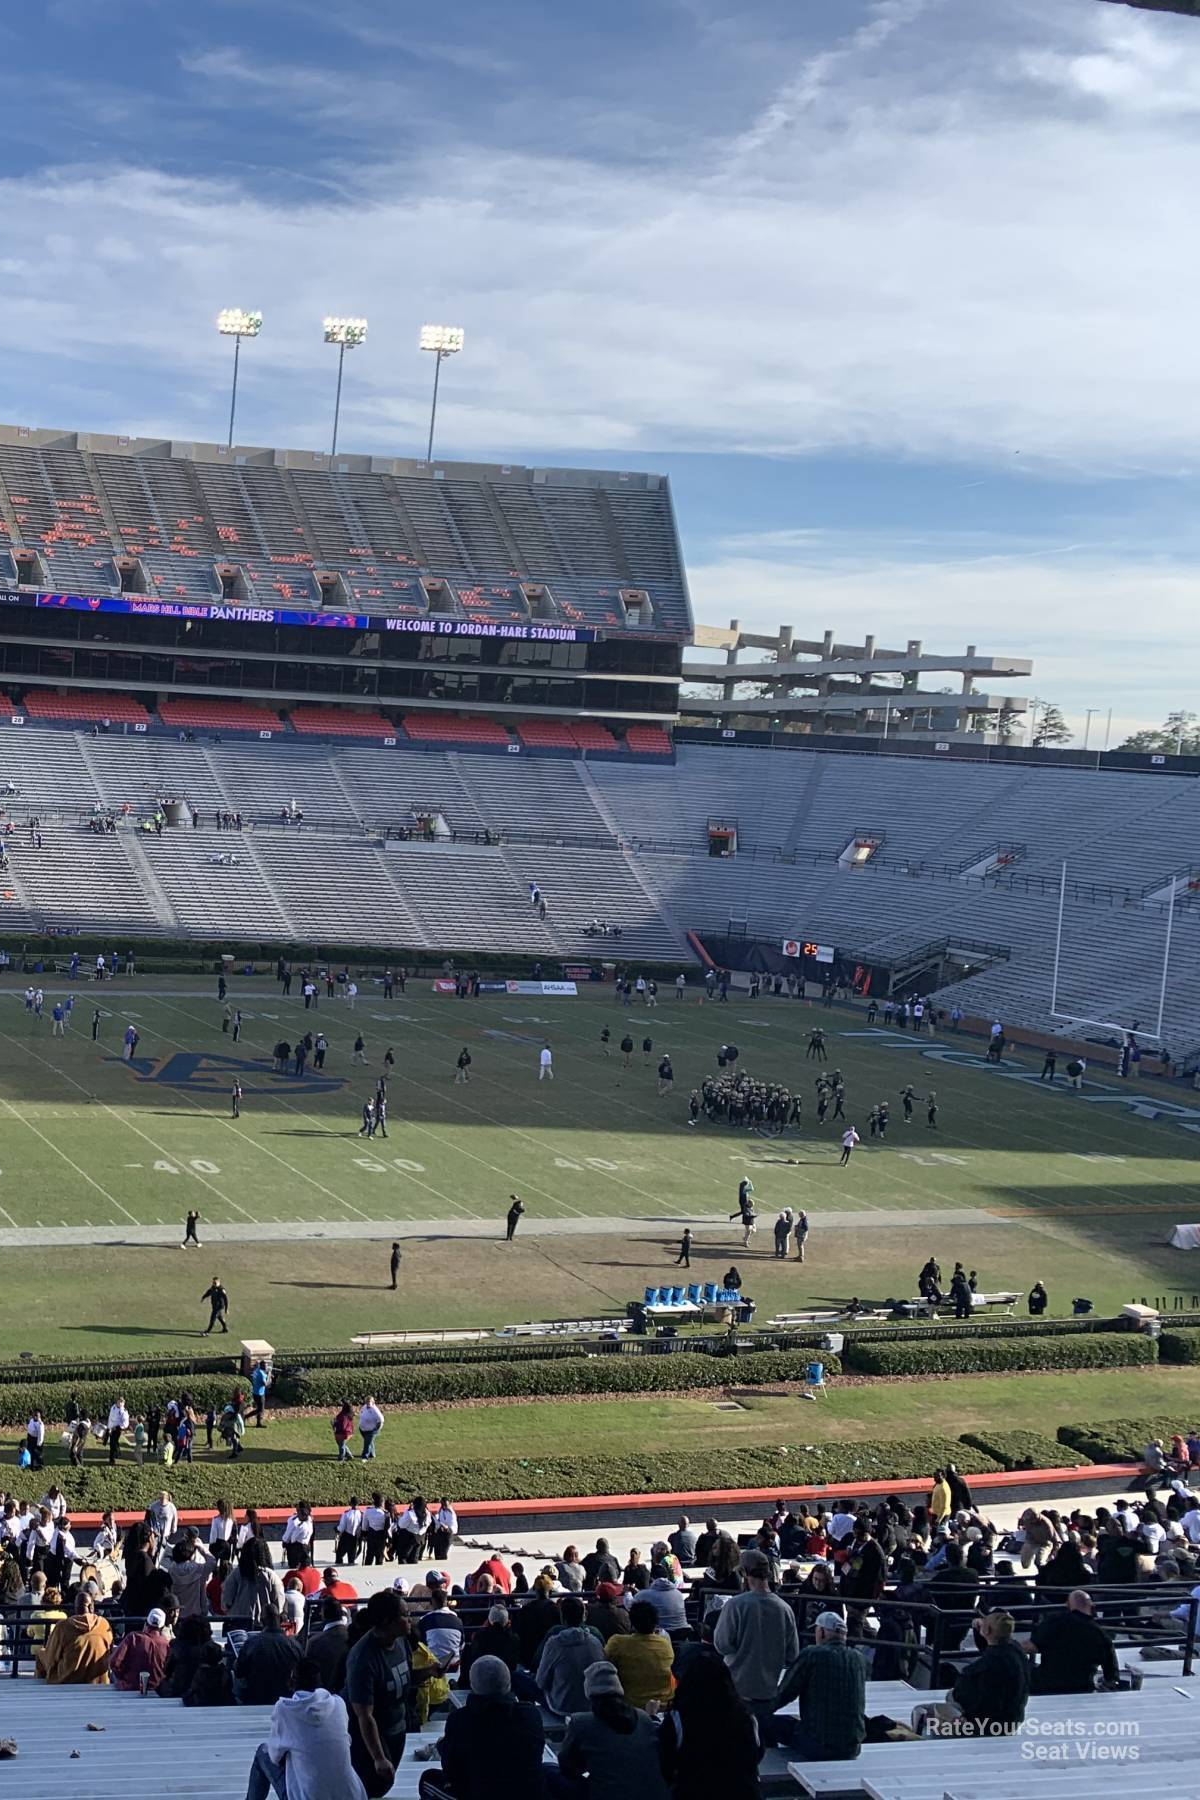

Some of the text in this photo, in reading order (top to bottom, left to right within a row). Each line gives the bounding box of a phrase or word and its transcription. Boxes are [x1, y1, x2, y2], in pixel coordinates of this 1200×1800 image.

[8, 594, 20, 602] ON
[161, 605, 181, 615] HILL
[210, 606, 275, 622] PANTHERS
[386, 619, 577, 641] WELCOME TO JORDAN-HARE STADIUM
[804, 943, 817, 955] 25
[153, 1159, 221, 1175] 40
[351, 1158, 426, 1173] 50
